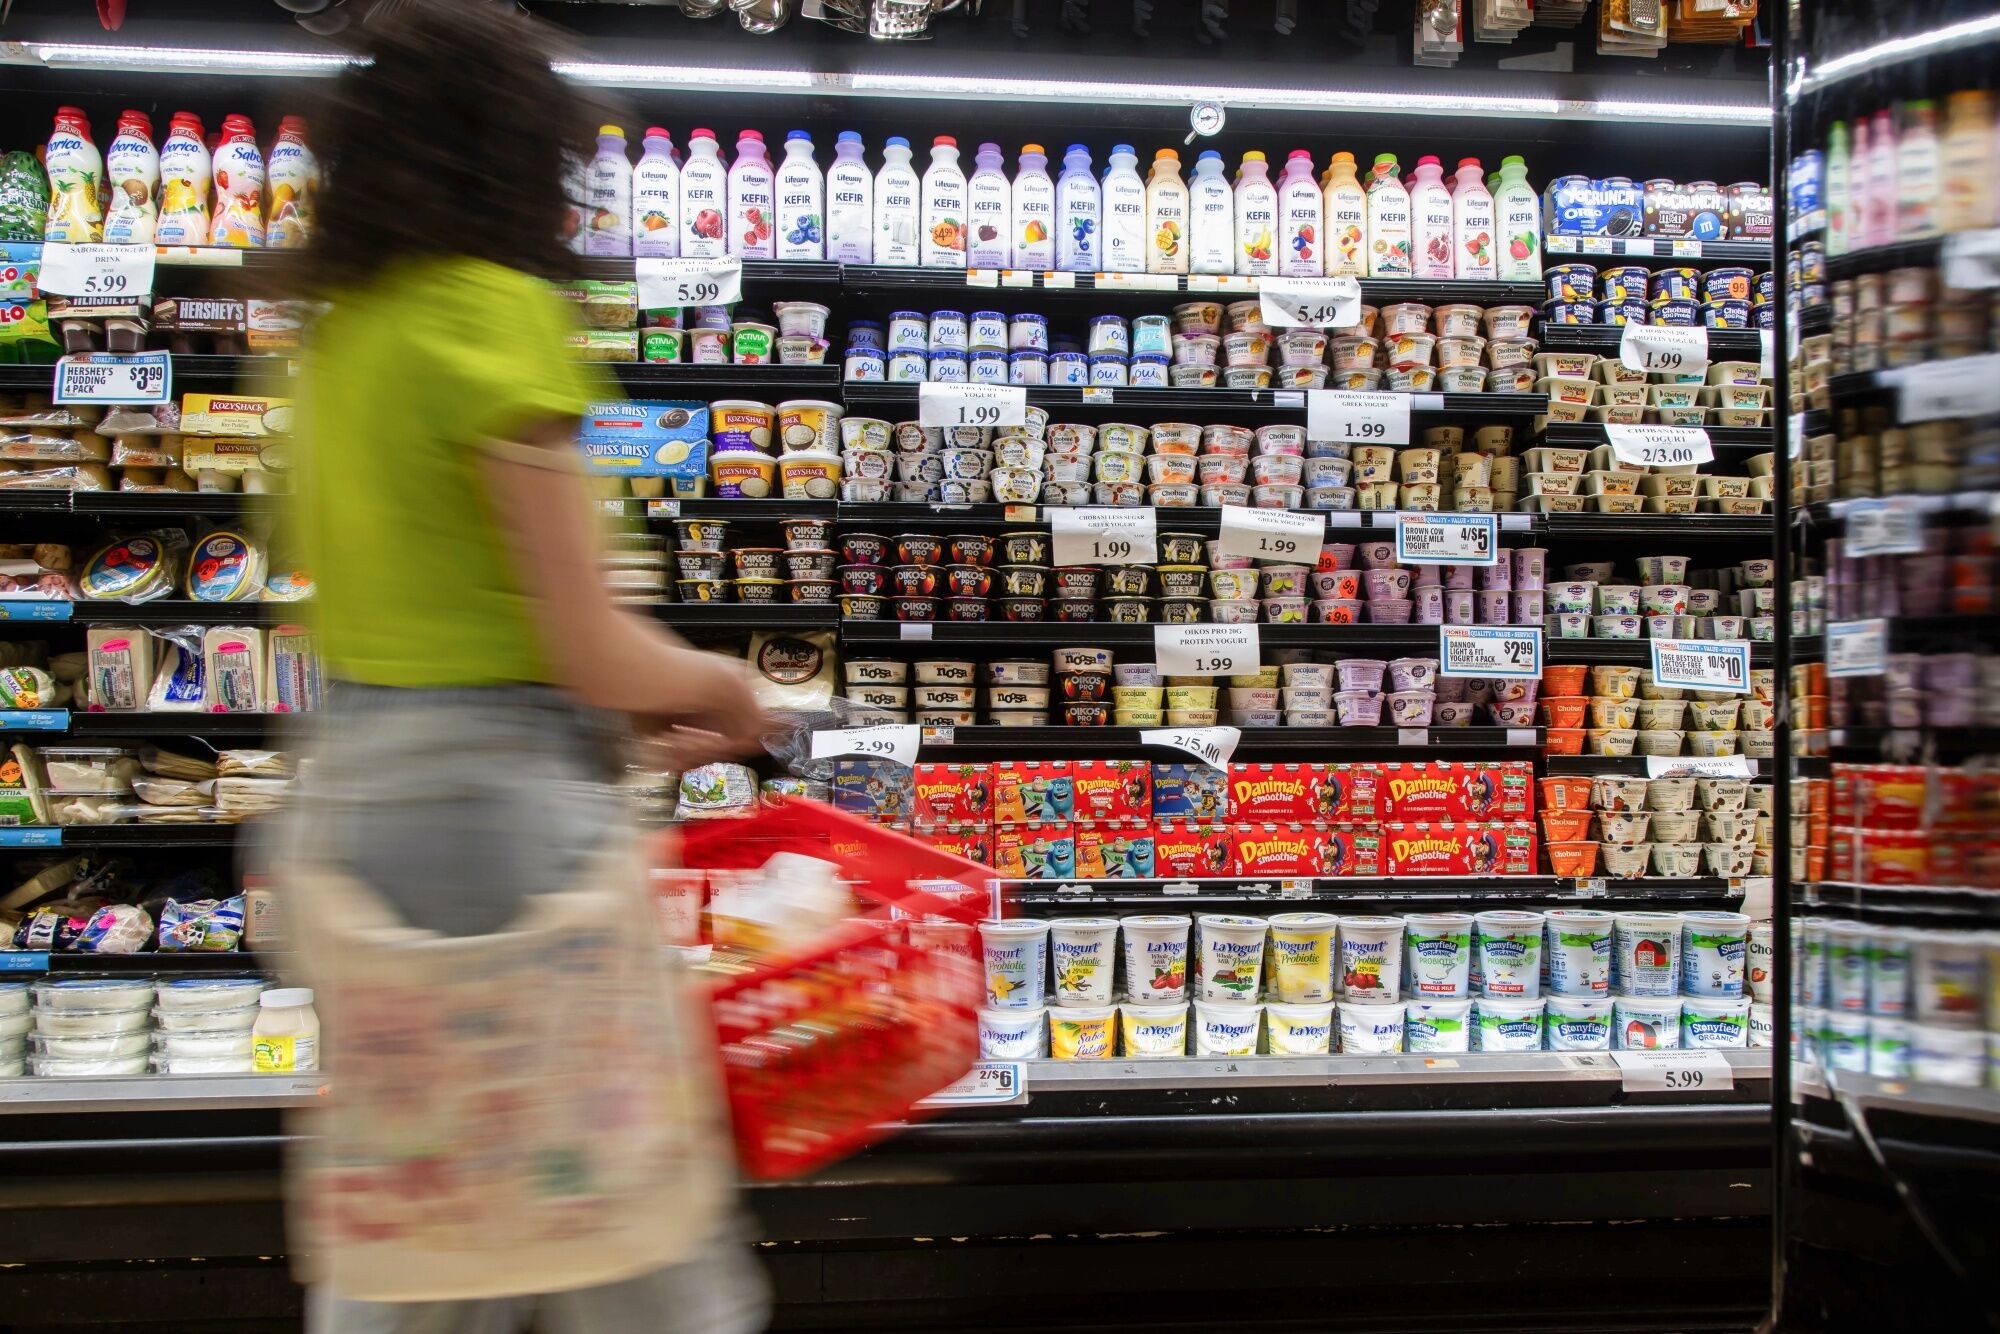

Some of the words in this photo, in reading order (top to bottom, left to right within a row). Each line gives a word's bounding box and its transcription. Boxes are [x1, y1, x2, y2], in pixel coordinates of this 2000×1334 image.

[785, 175, 809, 183] Lifeway
[837, 174, 863, 182] Lifeway
[935, 180, 959, 188] Lifeway
[688, 190, 713, 199] KEFIR
[742, 194, 769, 203] KEFIR
[835, 193, 863, 202] KEFIR
[784, 195, 811, 204] KEFIR
[887, 196, 910, 205] KEFIR
[934, 199, 960, 208] KEFIR
[975, 202, 1001, 211] KEFIR
[1023, 203, 1049, 211] KEFIR
[1070, 201, 1095, 211] KEFIR
[1114, 204, 1141, 213] KEFIR
[1158, 208, 1181, 217] KEFIR
[1246, 211, 1270, 220] KEFIR
[1292, 210, 1316, 219] KEFIR
[1337, 212, 1361, 220] KEFIR
[1564, 208, 1602, 219] OREO
[1381, 213, 1406, 222] KEFIR
[1427, 215, 1450, 224] KEFIR
[1466, 218, 1490, 226] KEFIR
[1509, 213, 1533, 222] KEFIR
[85, 276, 127, 292] 5.99
[678, 283, 719, 301] 5.99
[179, 300, 244, 321] HERSHEY'S
[1297, 305, 1336, 322] 5.49
[737, 334, 765, 342] ACTIVIA
[1644, 352, 1682, 369] 1.99
[67, 367, 113, 376] HERSHEY'S
[67, 376, 106, 385] PUDDING
[65, 385, 70, 393] 4
[73, 385, 94, 393] PACK
[211, 401, 264, 412] KOZYSHACK
[587, 404, 619, 415] SWISS
[622, 405, 648, 417] MISS
[958, 406, 1000, 424] 1.99
[727, 416, 767, 424] KOZYSHACK
[1345, 423, 1385, 437] 1.99
[217, 444, 259, 452] KOZYSHACK
[585, 444, 619, 456] SWISS
[621, 445, 650, 457] MISS
[1642, 448, 1693, 462] 2/3.00
[787, 468, 825, 476] KOZYSHACK
[792, 526, 824, 535] OIKOS
[1461, 528, 1488, 550] 4/$5
[904, 542, 935, 550] OIKOS
[957, 541, 987, 550] OIKOS
[1093, 542, 1131, 557] 1.99
[1259, 538, 1296, 553] 1.99
[742, 555, 773, 563] OIKOS
[1196, 658, 1232, 670] 1.99
[1708, 656, 1740, 678] 10/$10
[859, 668, 892, 678] noosa
[937, 667, 967, 678] noosa
[927, 692, 959, 703] noosa
[854, 741, 895, 753] 2.99
[1174, 736, 1220, 763] 2/5.00
[917, 782, 963, 799] Danimals
[1234, 775, 1306, 804] Danimals
[1389, 774, 1459, 802] Danimals
[1252, 793, 1294, 803] smoothie
[1407, 790, 1447, 802] smoothie
[1419, 942, 1456, 951] Stonyfield
[1067, 957, 1101, 967] Probiotic
[1560, 1024, 1606, 1034] Stonyfield
[1567, 1034, 1601, 1042] ORGANIC
[980, 1070, 1012, 1087] 2/$6
[1666, 1071, 1703, 1088] 5.99
